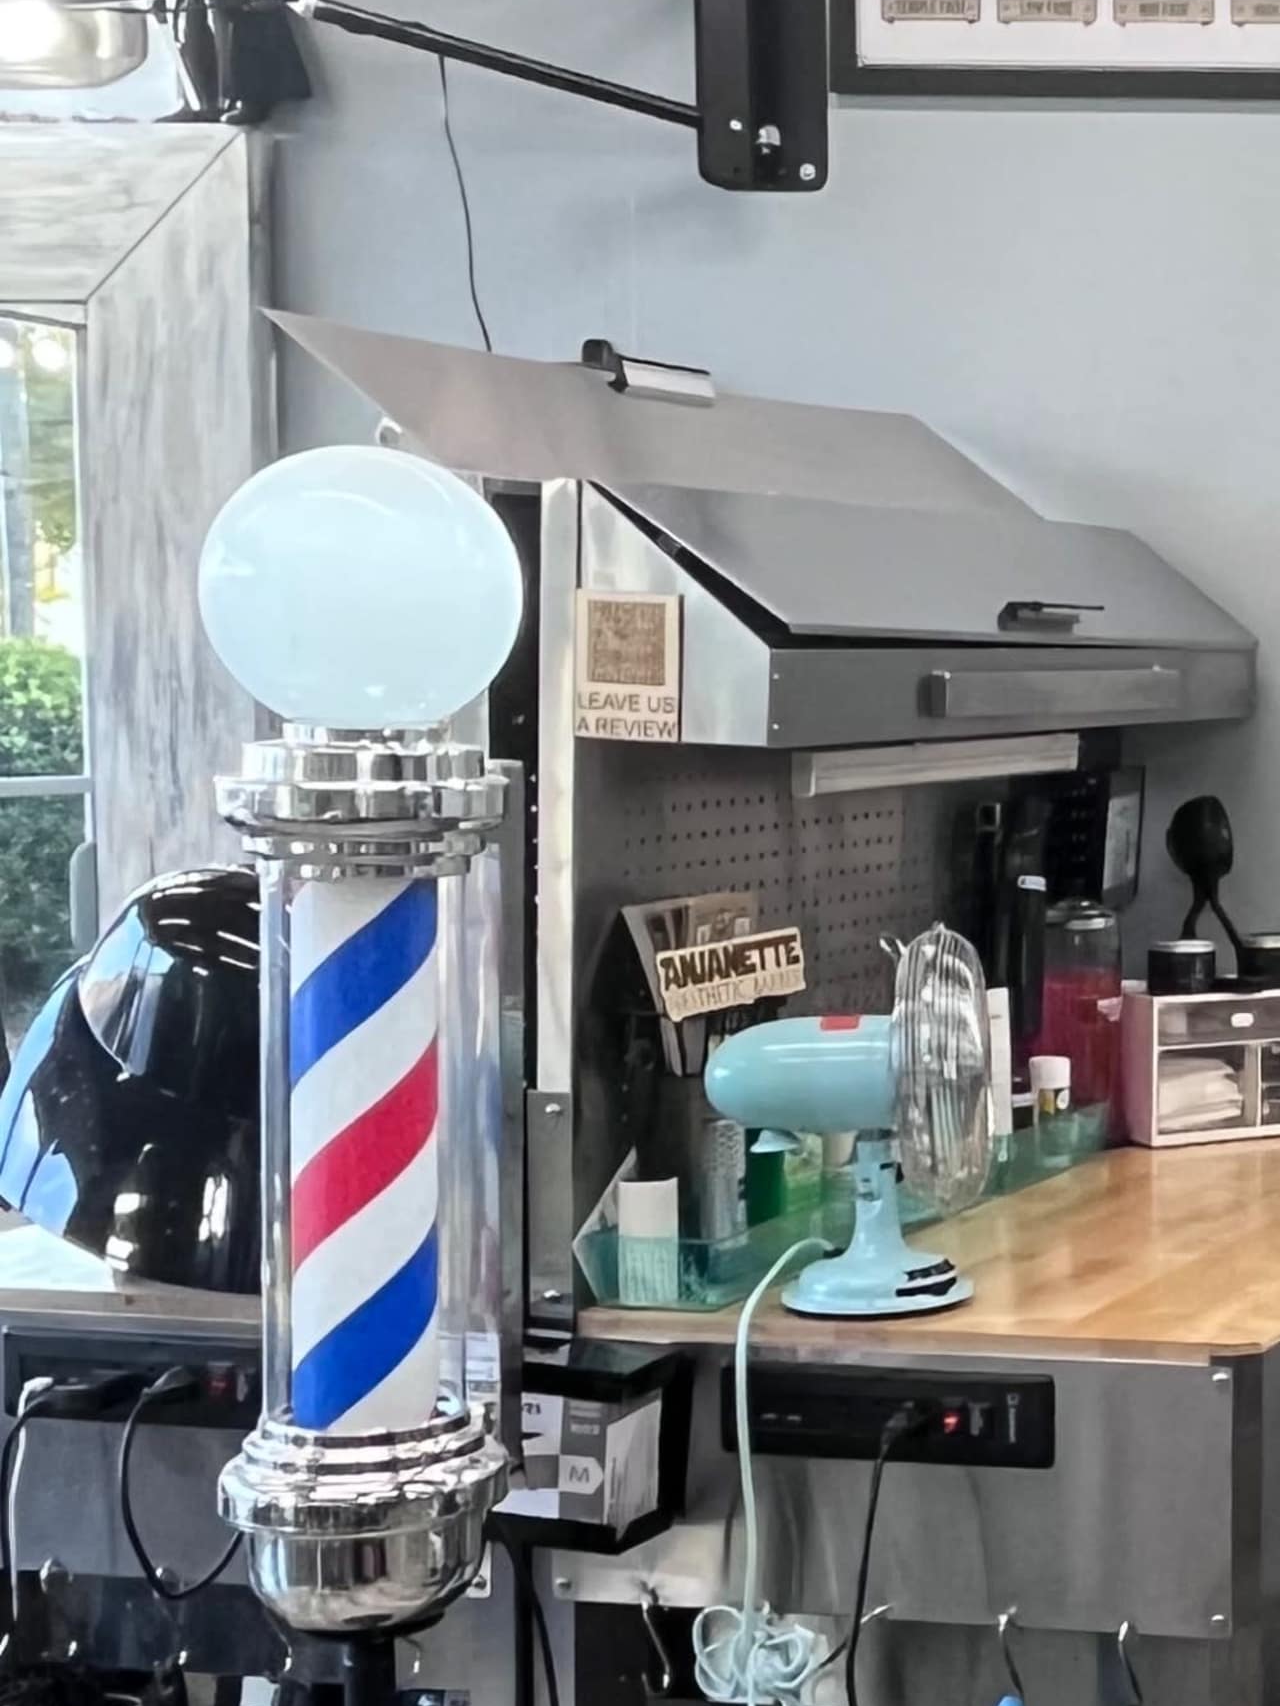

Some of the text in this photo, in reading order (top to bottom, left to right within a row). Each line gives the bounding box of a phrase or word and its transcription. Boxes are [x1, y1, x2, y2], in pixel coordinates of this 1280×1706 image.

[577, 692, 677, 714] LEAVE US
[577, 716, 677, 738] A REVIEW
[568, 1465, 590, 1483] M
